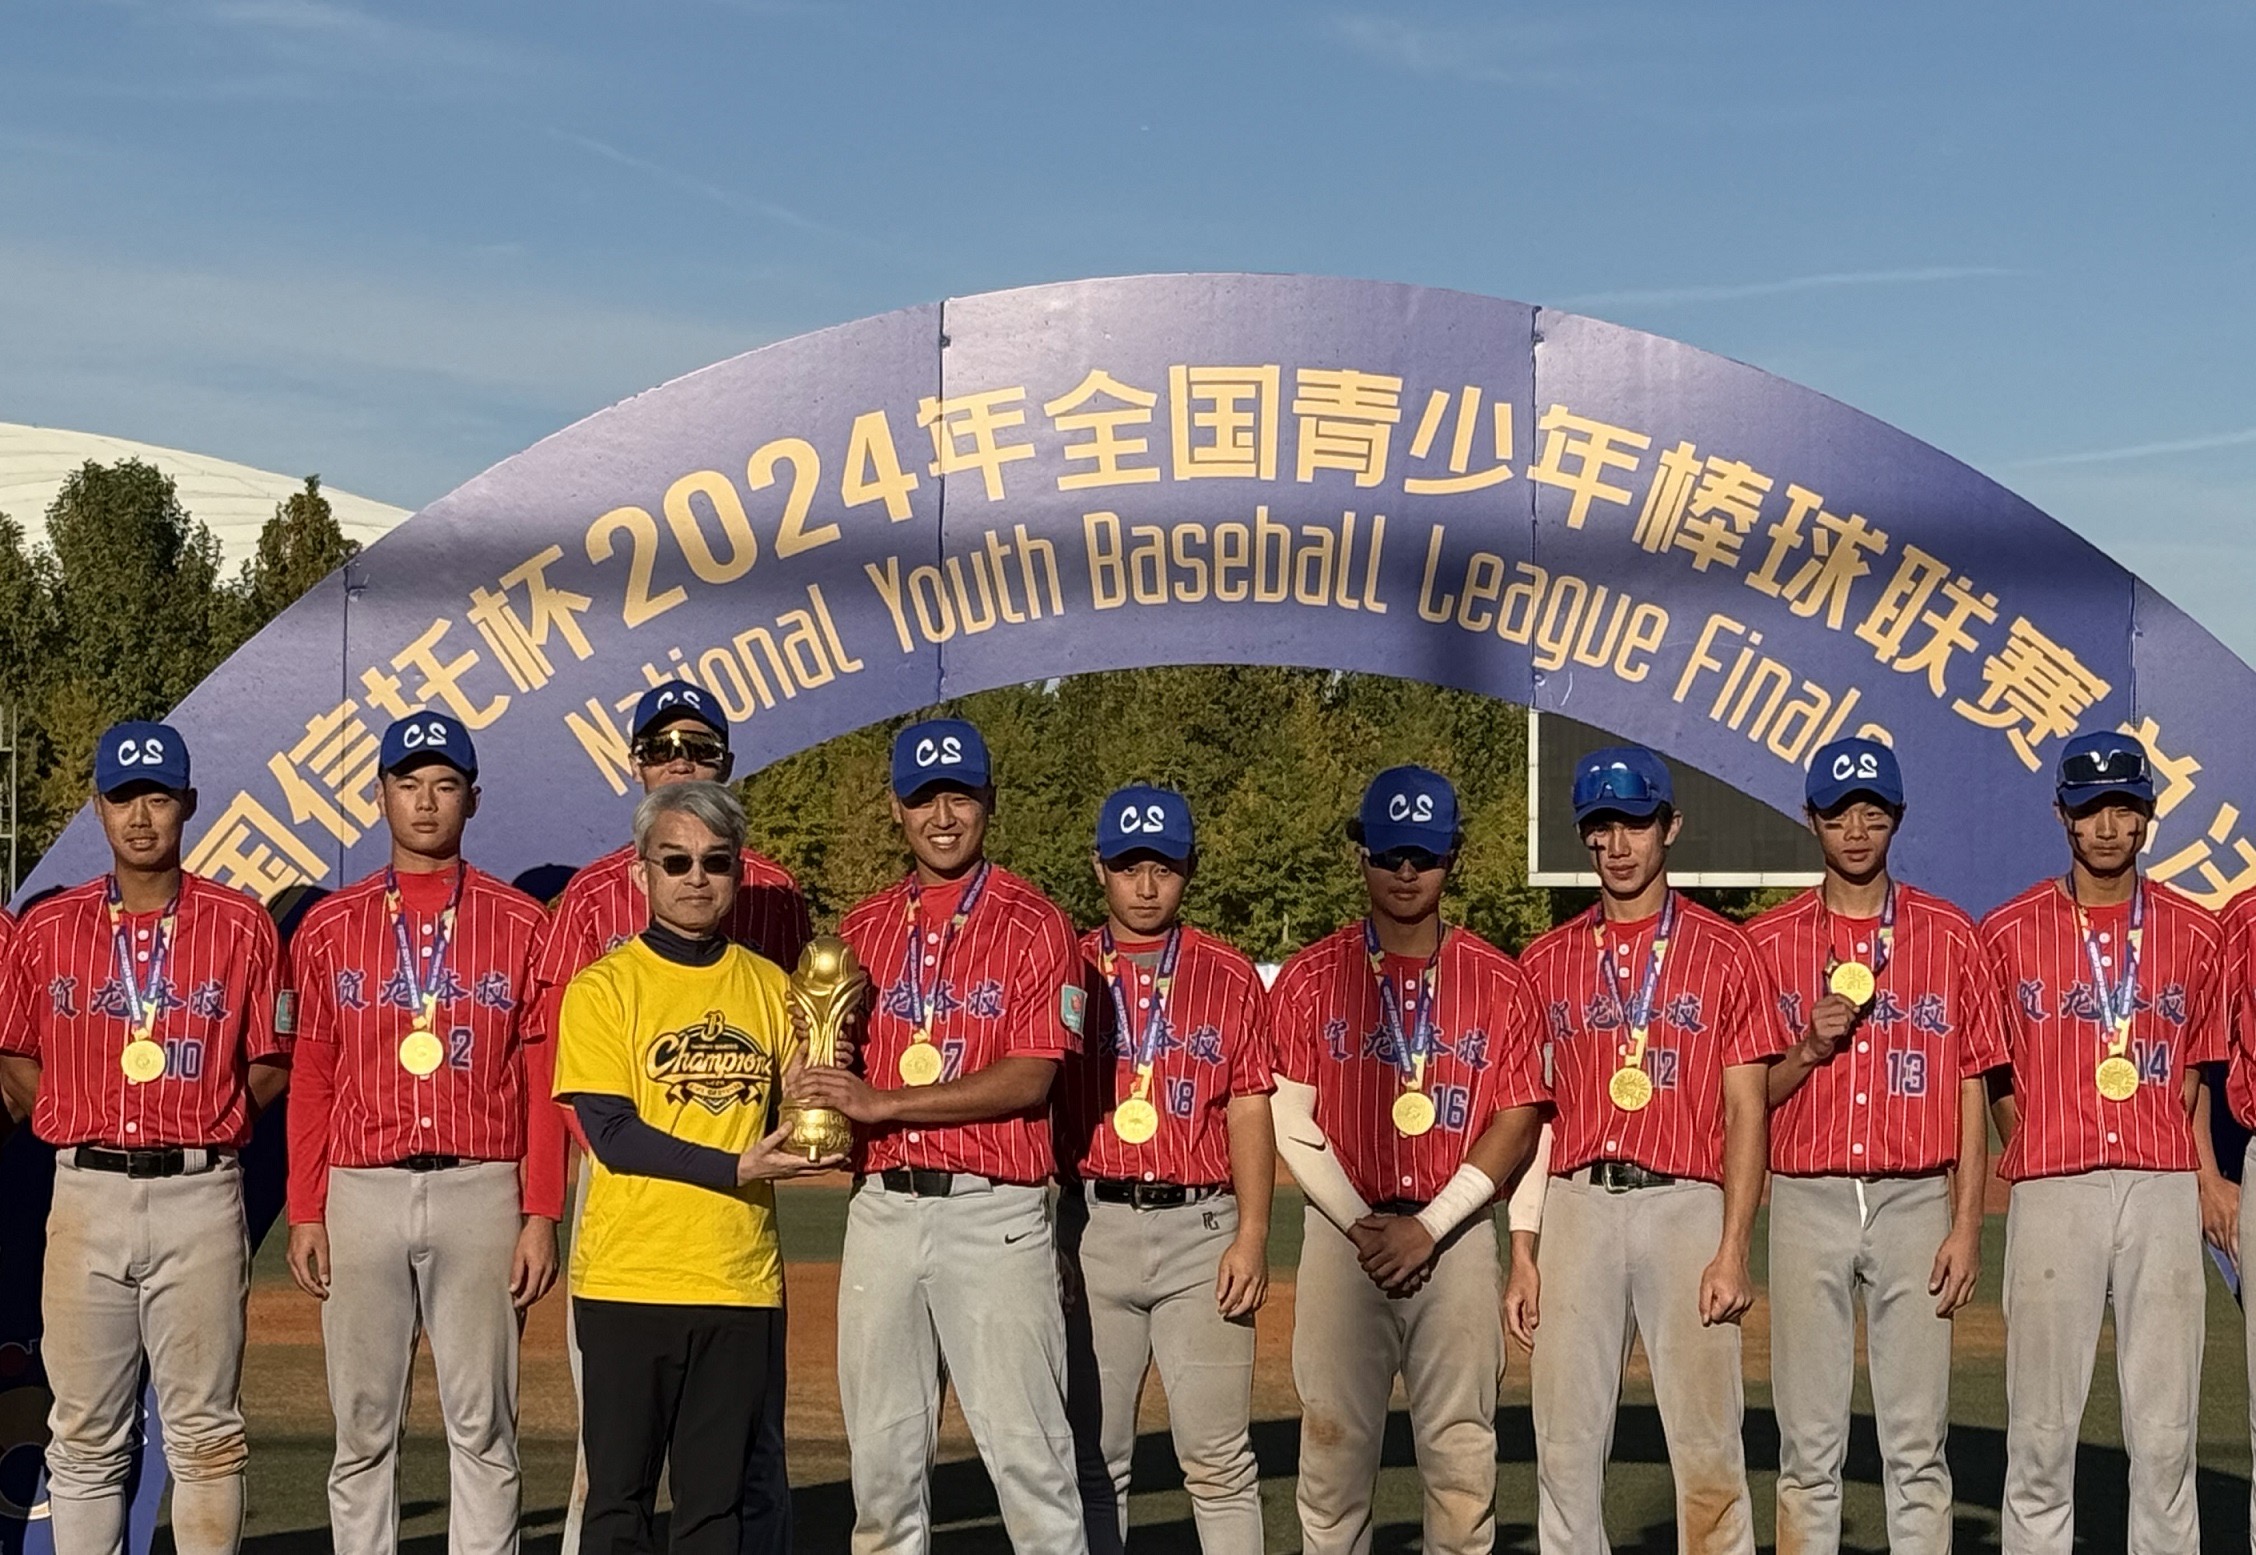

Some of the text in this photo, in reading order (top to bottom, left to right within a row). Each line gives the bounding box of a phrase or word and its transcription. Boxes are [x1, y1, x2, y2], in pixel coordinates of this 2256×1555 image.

[864, 525, 1064, 653] Youth
[1083, 505, 1388, 614] Baseball
[1418, 525, 1669, 682] League
[1777, 989, 1955, 1038] 贺体校
[166, 1038, 205, 1082] 10
[450, 1026, 473, 1070] 2
[938, 1038, 967, 1084] 7
[1646, 1047, 1678, 1089] 12
[2132, 1038, 2170, 1087] 14
[1886, 1050, 1928, 1097] 13
[1166, 1076, 1196, 1119] 18
[1431, 1083, 1469, 1134] 16
